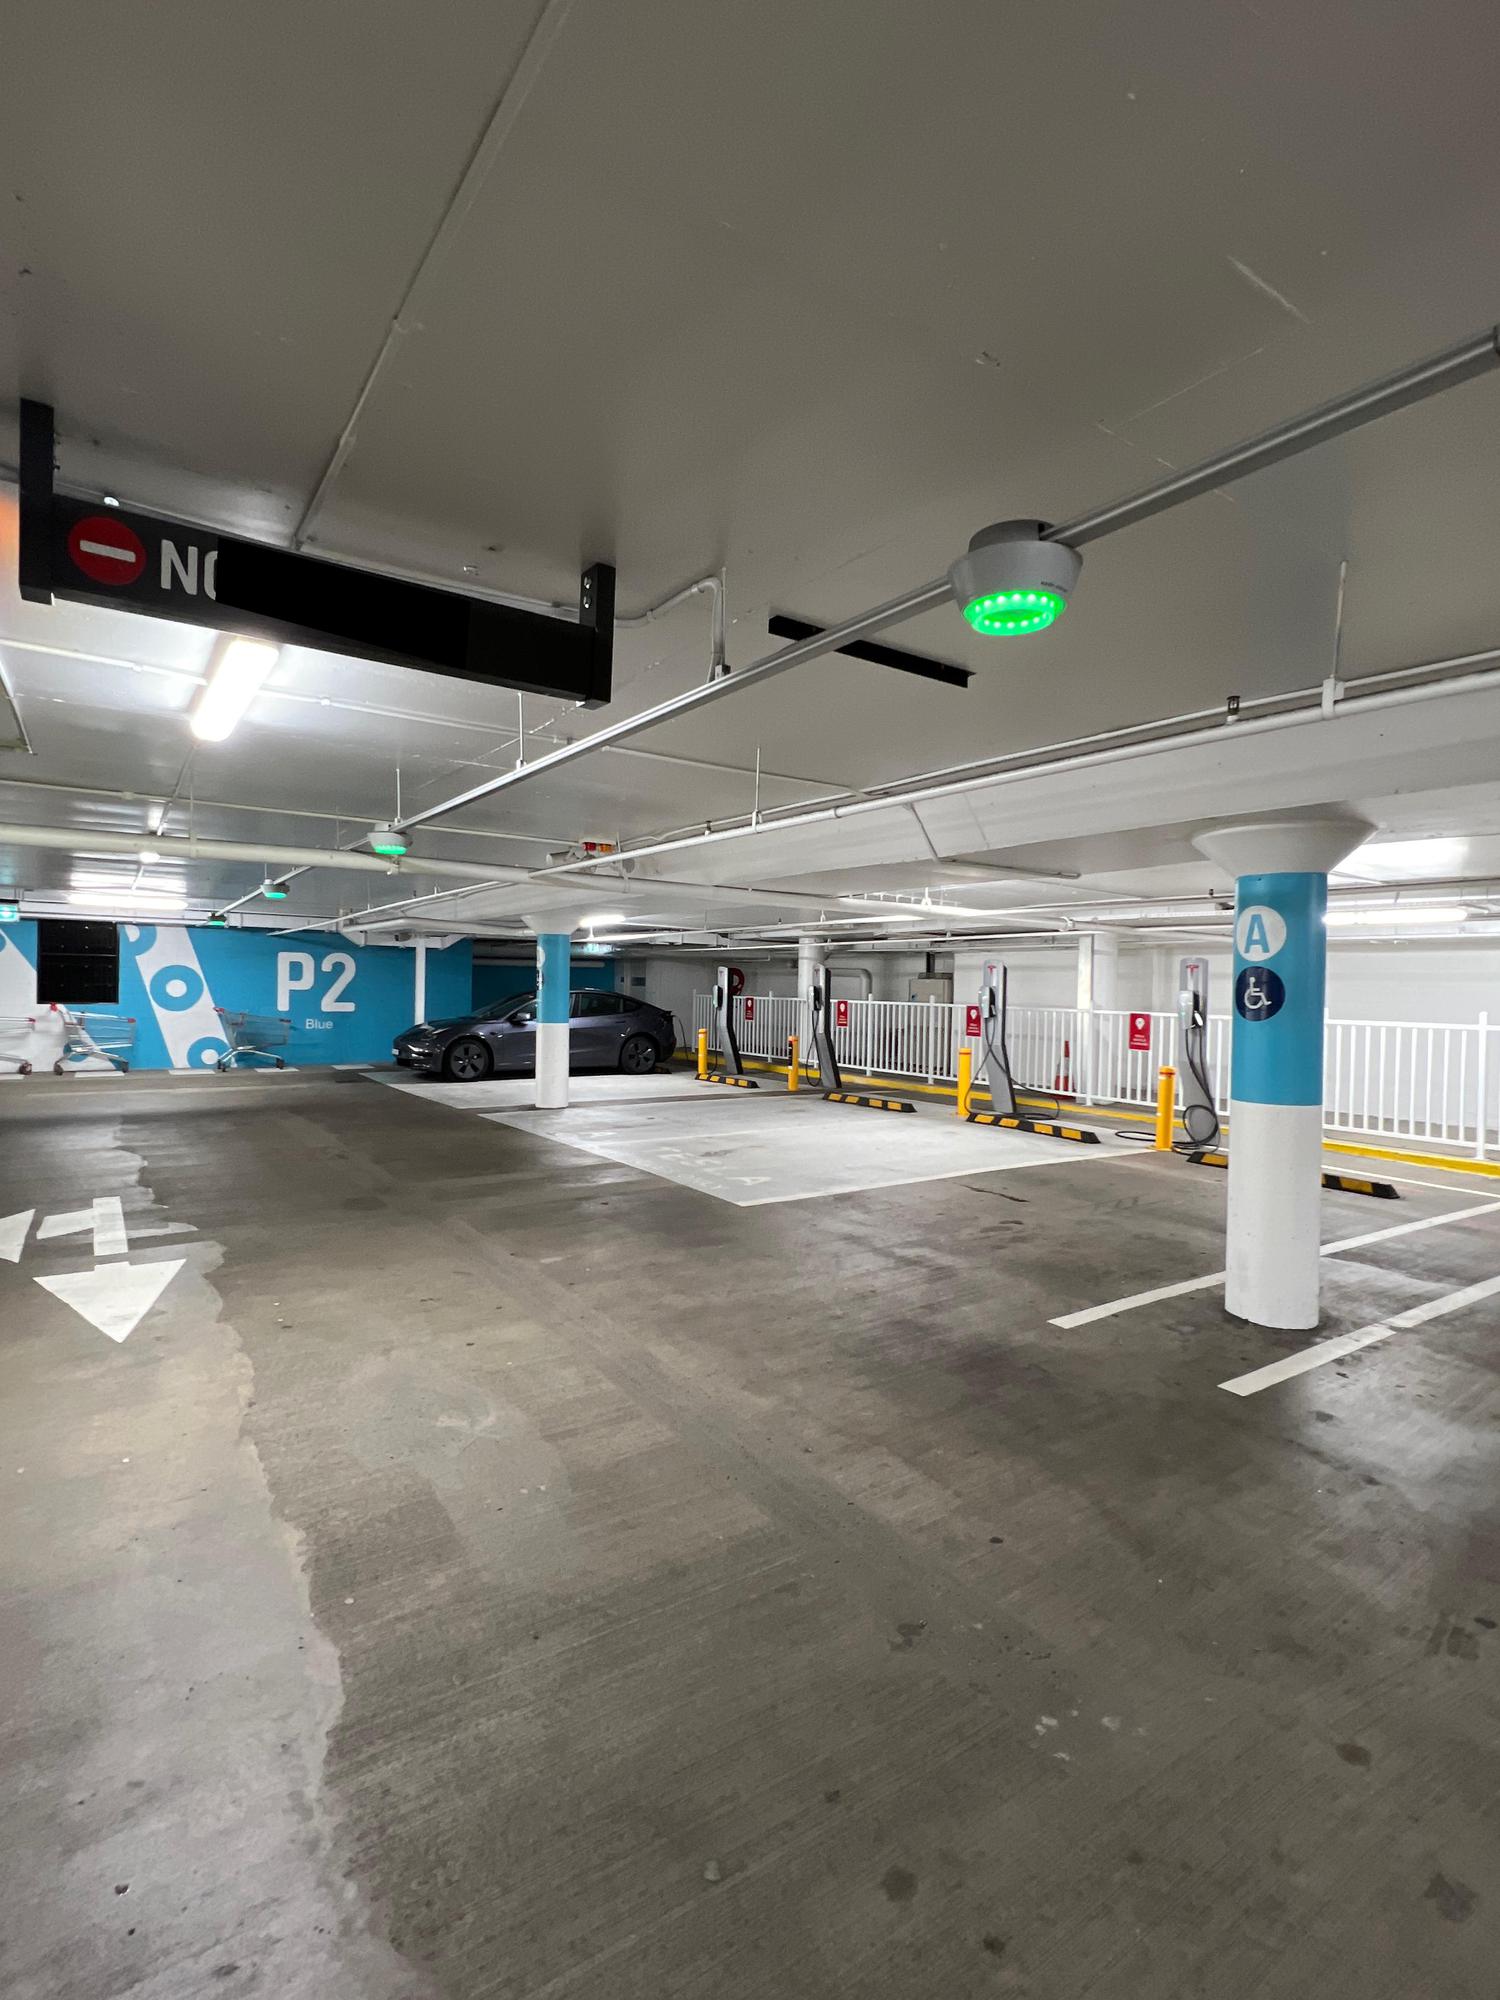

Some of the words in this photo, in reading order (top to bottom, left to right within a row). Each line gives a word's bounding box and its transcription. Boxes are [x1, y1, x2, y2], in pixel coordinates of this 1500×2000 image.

[1244, 914, 1270, 954] A
[276, 951, 357, 1012] P2
[305, 1018, 334, 1030] Blue
